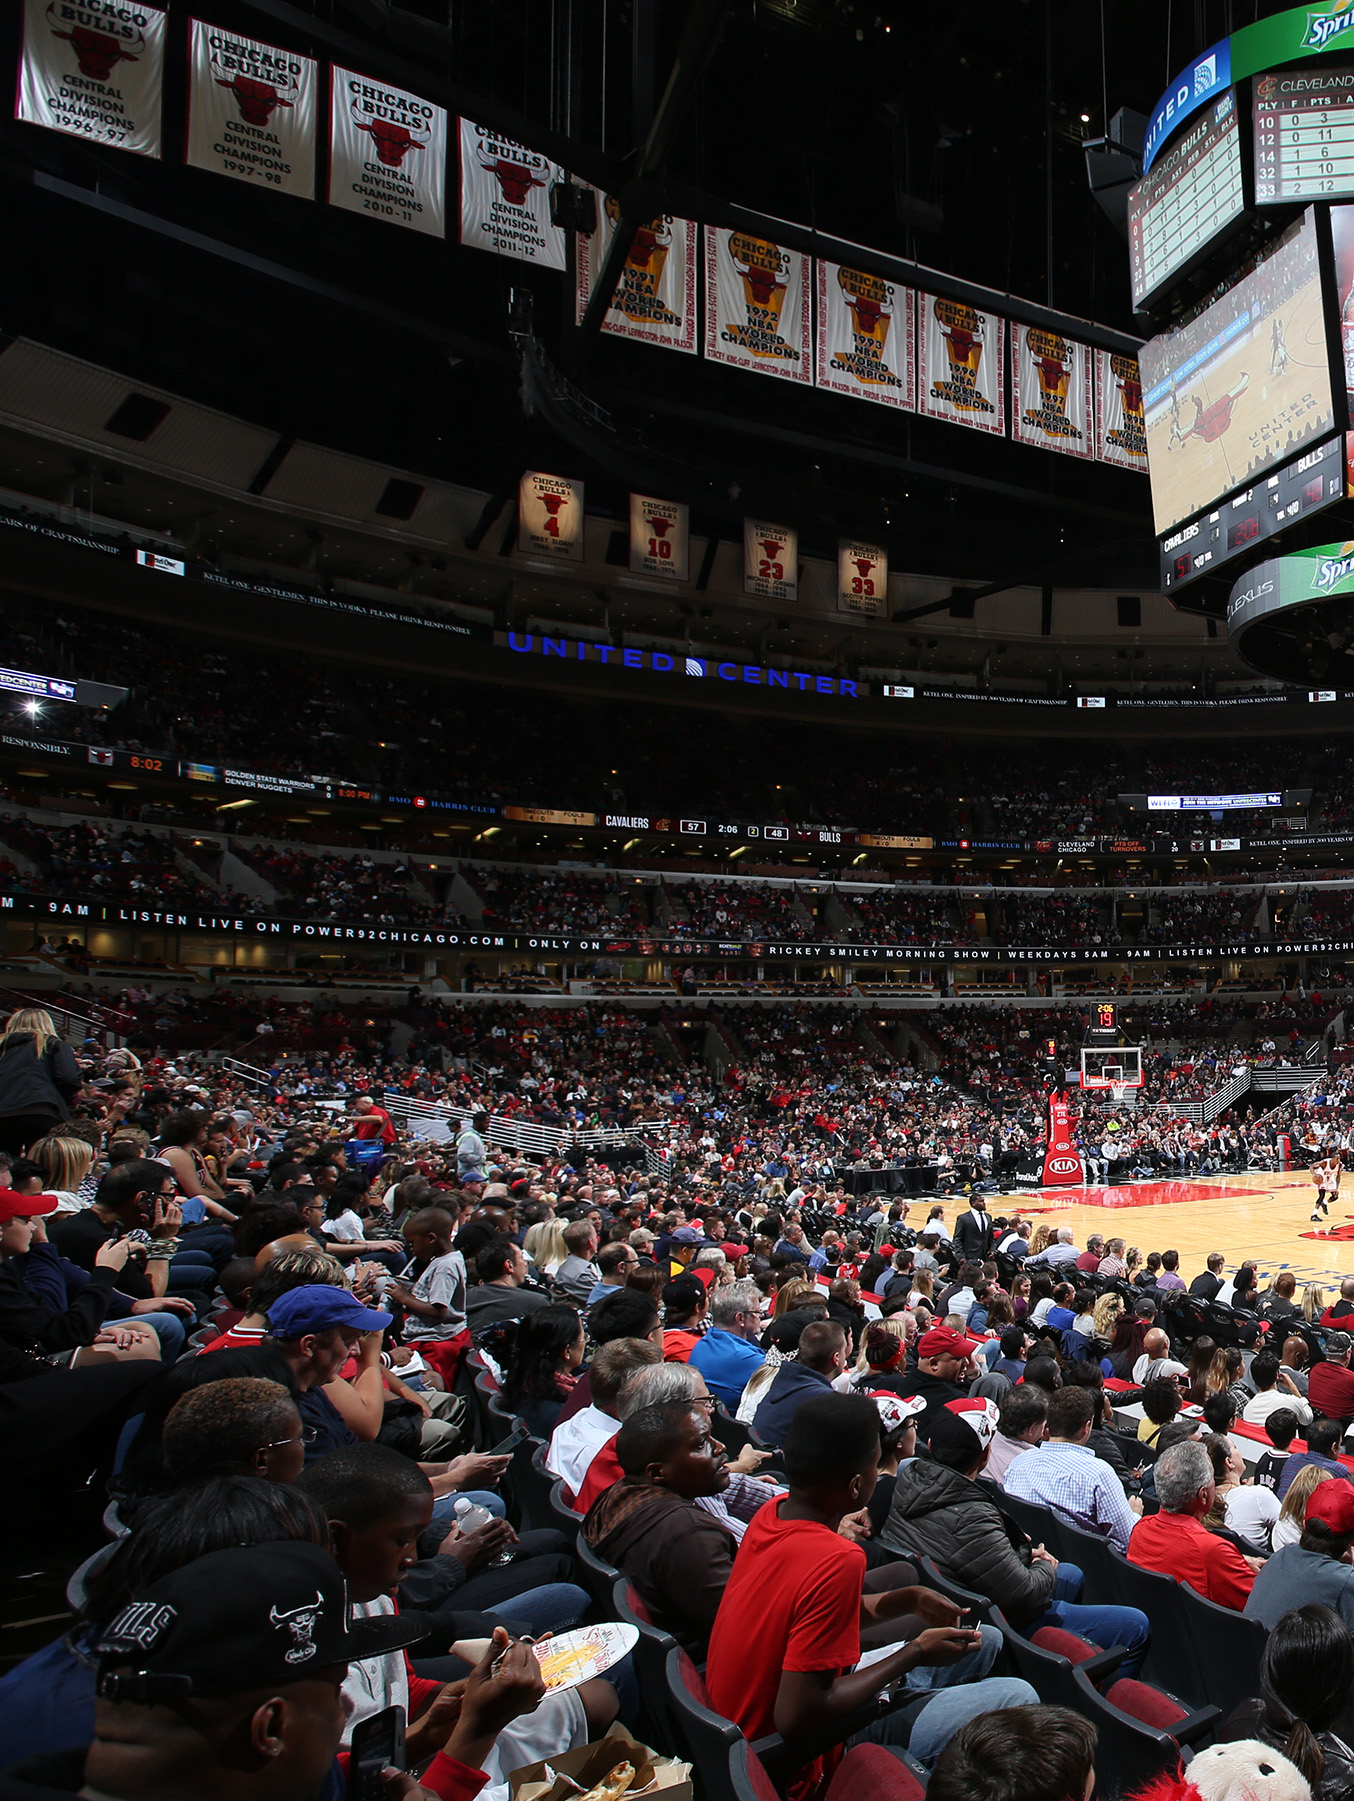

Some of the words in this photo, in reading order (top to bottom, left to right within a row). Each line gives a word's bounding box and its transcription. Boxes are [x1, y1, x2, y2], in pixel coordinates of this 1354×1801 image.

[209, 35, 301, 75] CHICAGO
[222, 55, 288, 86] BULLS
[1281, 76, 1354, 92] CLEVELAND
[350, 80, 433, 119] CHICAGO
[1258, 102, 1277, 110] PLY
[1311, 98, 1331, 106] PTS
[362, 100, 422, 130] BULLS
[1259, 118, 1274, 129] 10
[226, 120, 280, 145] CENTRAL
[1260, 135, 1275, 145] 12
[1319, 130, 1332, 140] 11
[224, 132, 282, 158] DIVISION
[213, 143, 291, 175] CHAMPIONS
[1260, 152, 1275, 162] 14
[363, 161, 413, 185] CENTRAL
[1260, 169, 1275, 179] 32
[361, 173, 415, 198] DIVISION
[1260, 185, 1275, 196] 33
[352, 183, 423, 213] CHAMPIONS
[733, 236, 790, 263] CHICAGO
[742, 252, 783, 273] BULLS
[622, 267, 655, 285] 1991
[624, 278, 653, 295] NBA
[745, 305, 778, 322] 1992
[747, 316, 774, 332] NBA
[737, 324, 785, 345] WORLD
[720, 331, 800, 361] CHAMPIONS
[1040, 391, 1064, 404] 1997
[1034, 409, 1070, 426] WORLD
[1042, 402, 1063, 415] NBA
[1022, 416, 1082, 440] CHAMPIONS
[544, 517, 559, 537] 4
[648, 538, 671, 559] 10
[759, 560, 783, 580] 23
[852, 577, 874, 596] 33
[508, 632, 674, 671] UNITED
[718, 661, 858, 698] CENTER
[131, 756, 162, 772] 8:02
[225, 770, 254, 779] GOLDEN
[256, 775, 277, 784] STATE
[279, 778, 315, 789] WARRIORS
[225, 778, 256, 787] DENVER
[258, 783, 292, 794] NUGGETS
[389, 796, 411, 804] BMO
[431, 801, 468, 811] HARRIS
[471, 805, 495, 813] CLUB
[606, 815, 649, 829] CAVALIERS
[688, 823, 699, 831] 57
[718, 825, 737, 834] 2:06
[819, 832, 841, 843] BULLS
[50, 903, 89, 915] 9AM
[120, 910, 188, 925] LISTEN
[199, 917, 243, 930] LIVE
[257, 922, 280, 933] ON
[293, 924, 504, 946] POWER92CHICAGO.COM
[530, 939, 572, 949] ONLY
[580, 940, 600, 950] ON
[1098, 1004, 1113, 1012] 2:06
[1100, 1013, 1112, 1026] 19
[1054, 1160, 1074, 1170] KIA
[1016, 1172, 1038, 1182] TransUnion
